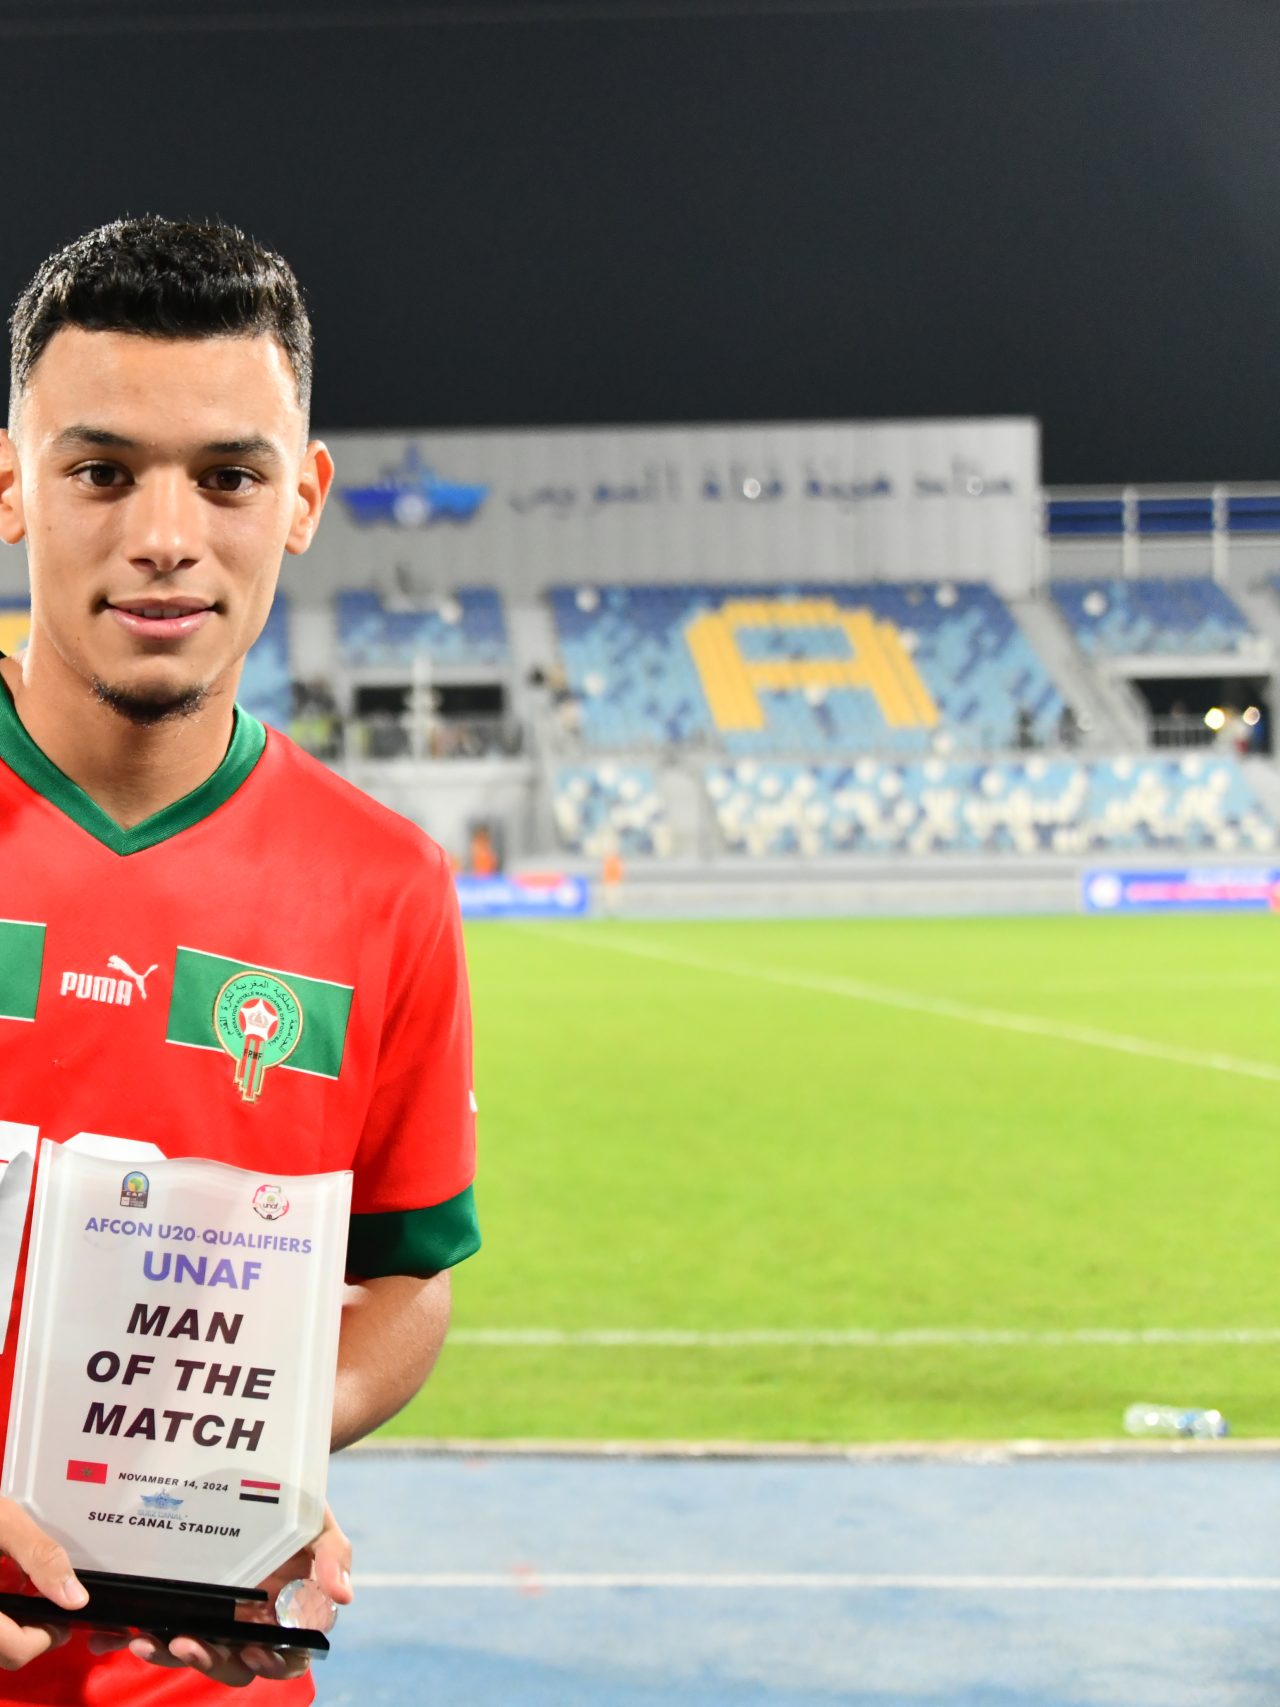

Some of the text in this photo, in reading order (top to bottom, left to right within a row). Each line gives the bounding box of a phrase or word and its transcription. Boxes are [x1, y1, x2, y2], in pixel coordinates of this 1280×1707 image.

[60, 971, 133, 1006] PUMA
[84, 1216, 153, 1238] AFCON
[142, 1250, 262, 1291] UNAF
[126, 1303, 244, 1345] MAN
[86, 1350, 276, 1400] OF THE
[82, 1402, 265, 1452] MATCH
[118, 1472, 229, 1492] NOVAMBER 14, 2024
[88, 1511, 241, 1538] SUEZ CANAL STADIUM
